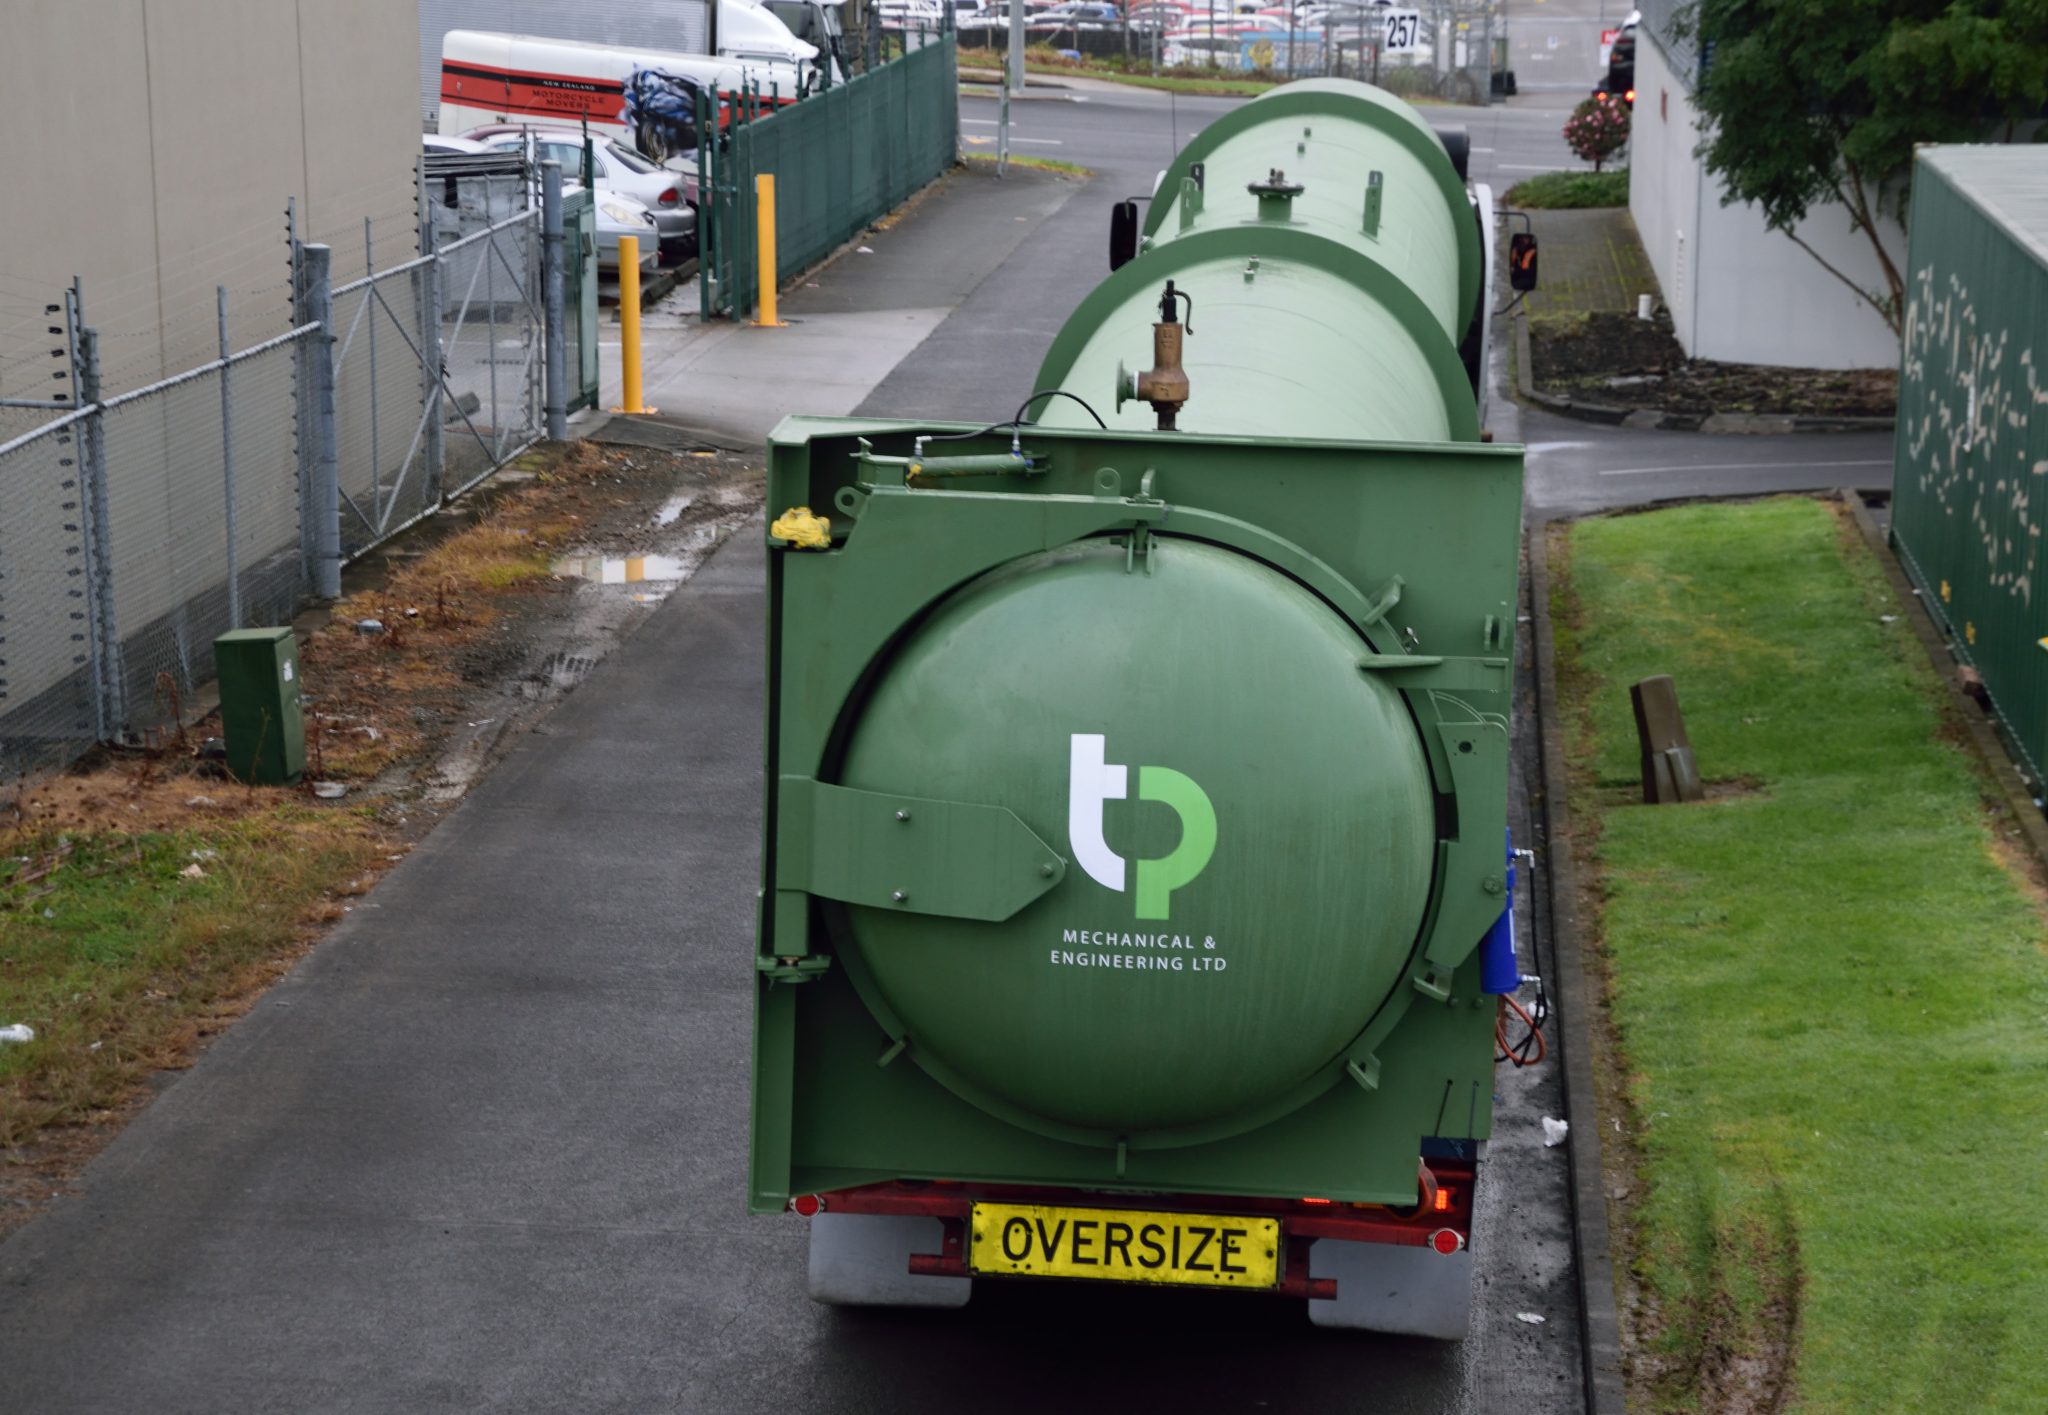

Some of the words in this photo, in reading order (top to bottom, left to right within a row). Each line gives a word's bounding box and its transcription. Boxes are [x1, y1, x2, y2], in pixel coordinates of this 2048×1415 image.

[1387, 15, 1417, 48] 257
[543, 80, 560, 88] NEW
[562, 82, 596, 91] ZEALAND
[532, 89, 605, 104] MOTORCYCLE
[546, 98, 590, 109] MOVERS
[1063, 929, 1194, 949] MECHANICAL
[1203, 935, 1216, 949] &
[1051, 950, 1183, 971] ENGINEERING
[1192, 957, 1227, 971] LTD
[1002, 1216, 1247, 1274] OVERSIZE
